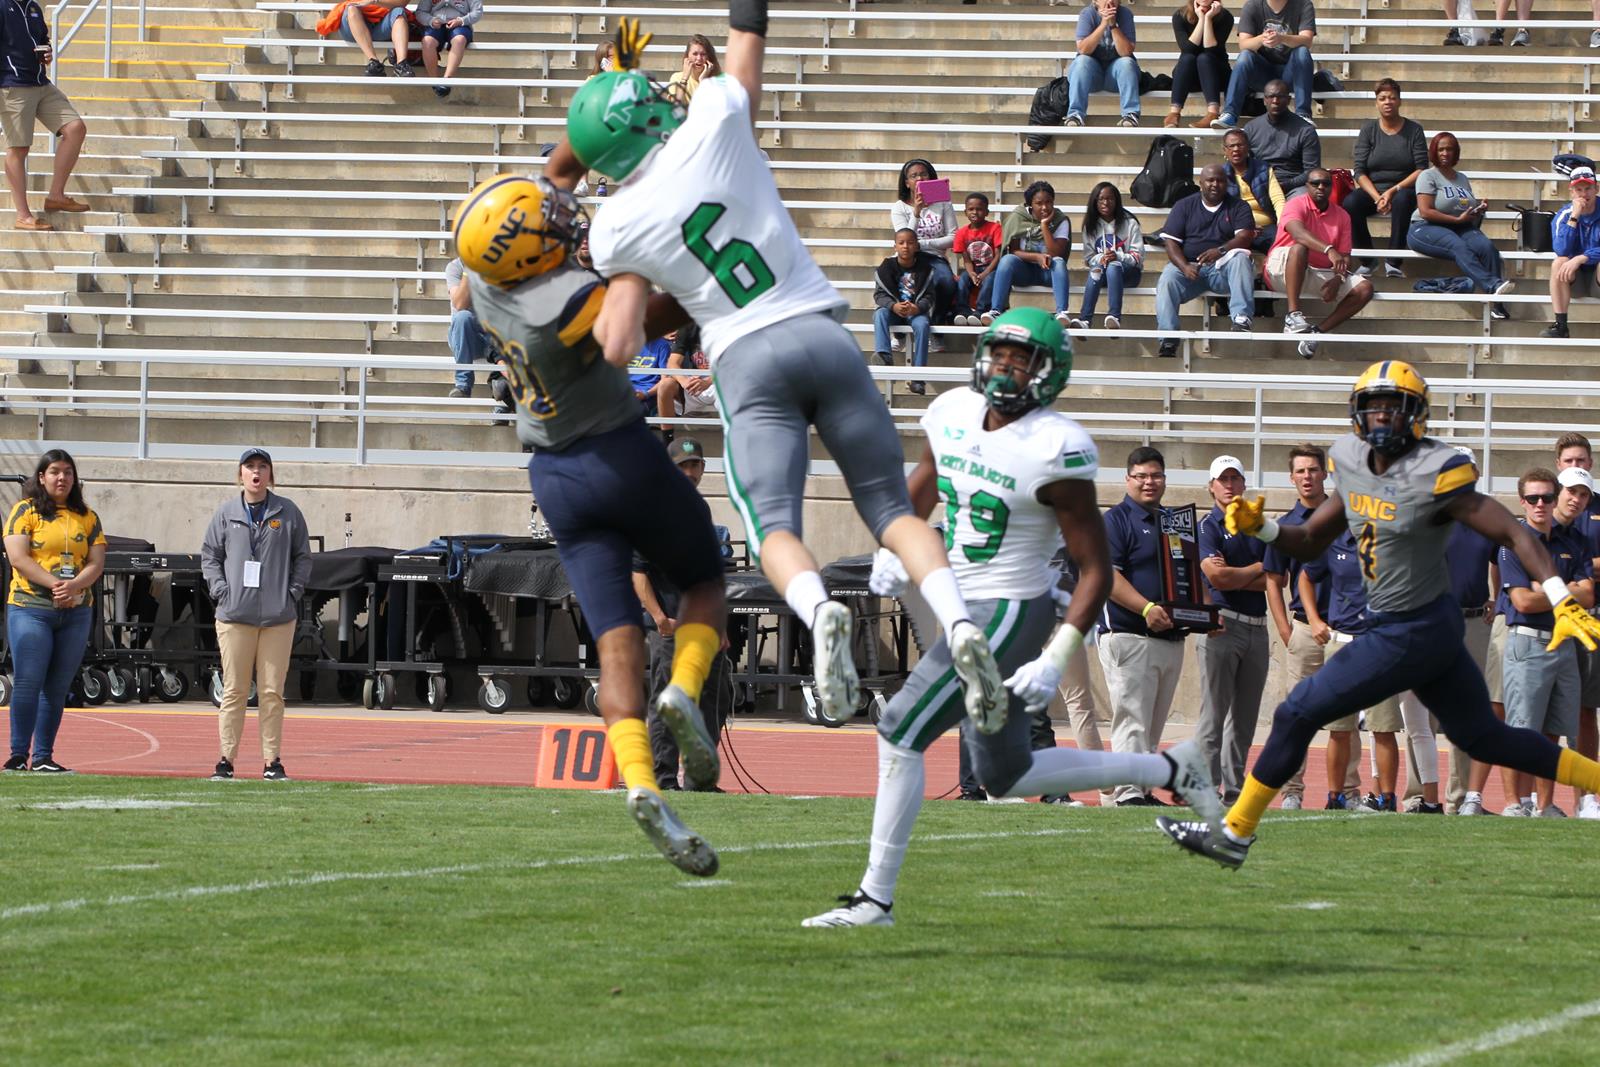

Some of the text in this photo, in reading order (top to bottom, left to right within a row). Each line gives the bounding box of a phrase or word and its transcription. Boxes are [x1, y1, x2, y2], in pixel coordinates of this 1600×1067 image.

[481, 206, 526, 265] UNC
[682, 202, 776, 308] 6
[1348, 490, 1397, 521] UNC
[1360, 520, 1377, 581] 4
[552, 729, 606, 781] 10
